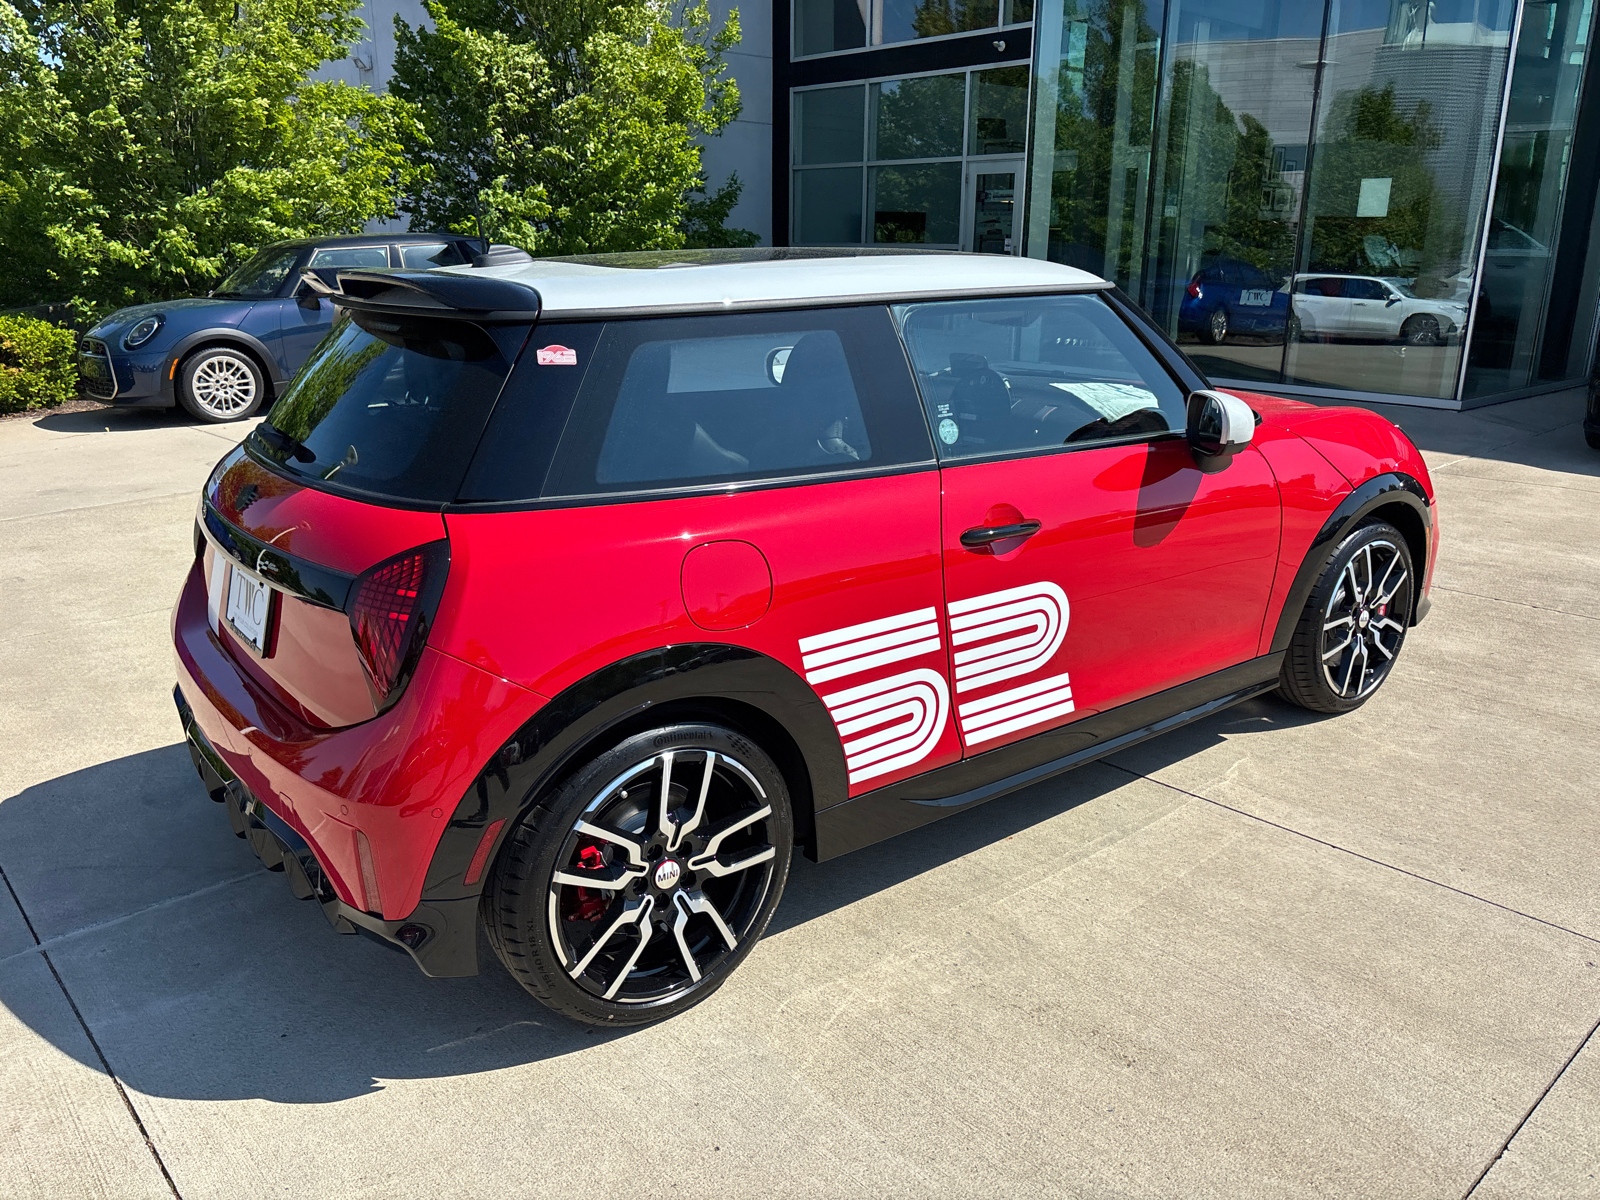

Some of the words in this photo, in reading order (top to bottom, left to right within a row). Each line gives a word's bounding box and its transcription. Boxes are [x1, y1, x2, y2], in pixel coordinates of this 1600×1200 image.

[236, 571, 264, 626] TWC
[799, 581, 1075, 785] 52
[652, 731, 706, 748] Continental
[657, 868, 679, 883] MINI
[526, 917, 534, 932] XL
[528, 936, 536, 948] 18
